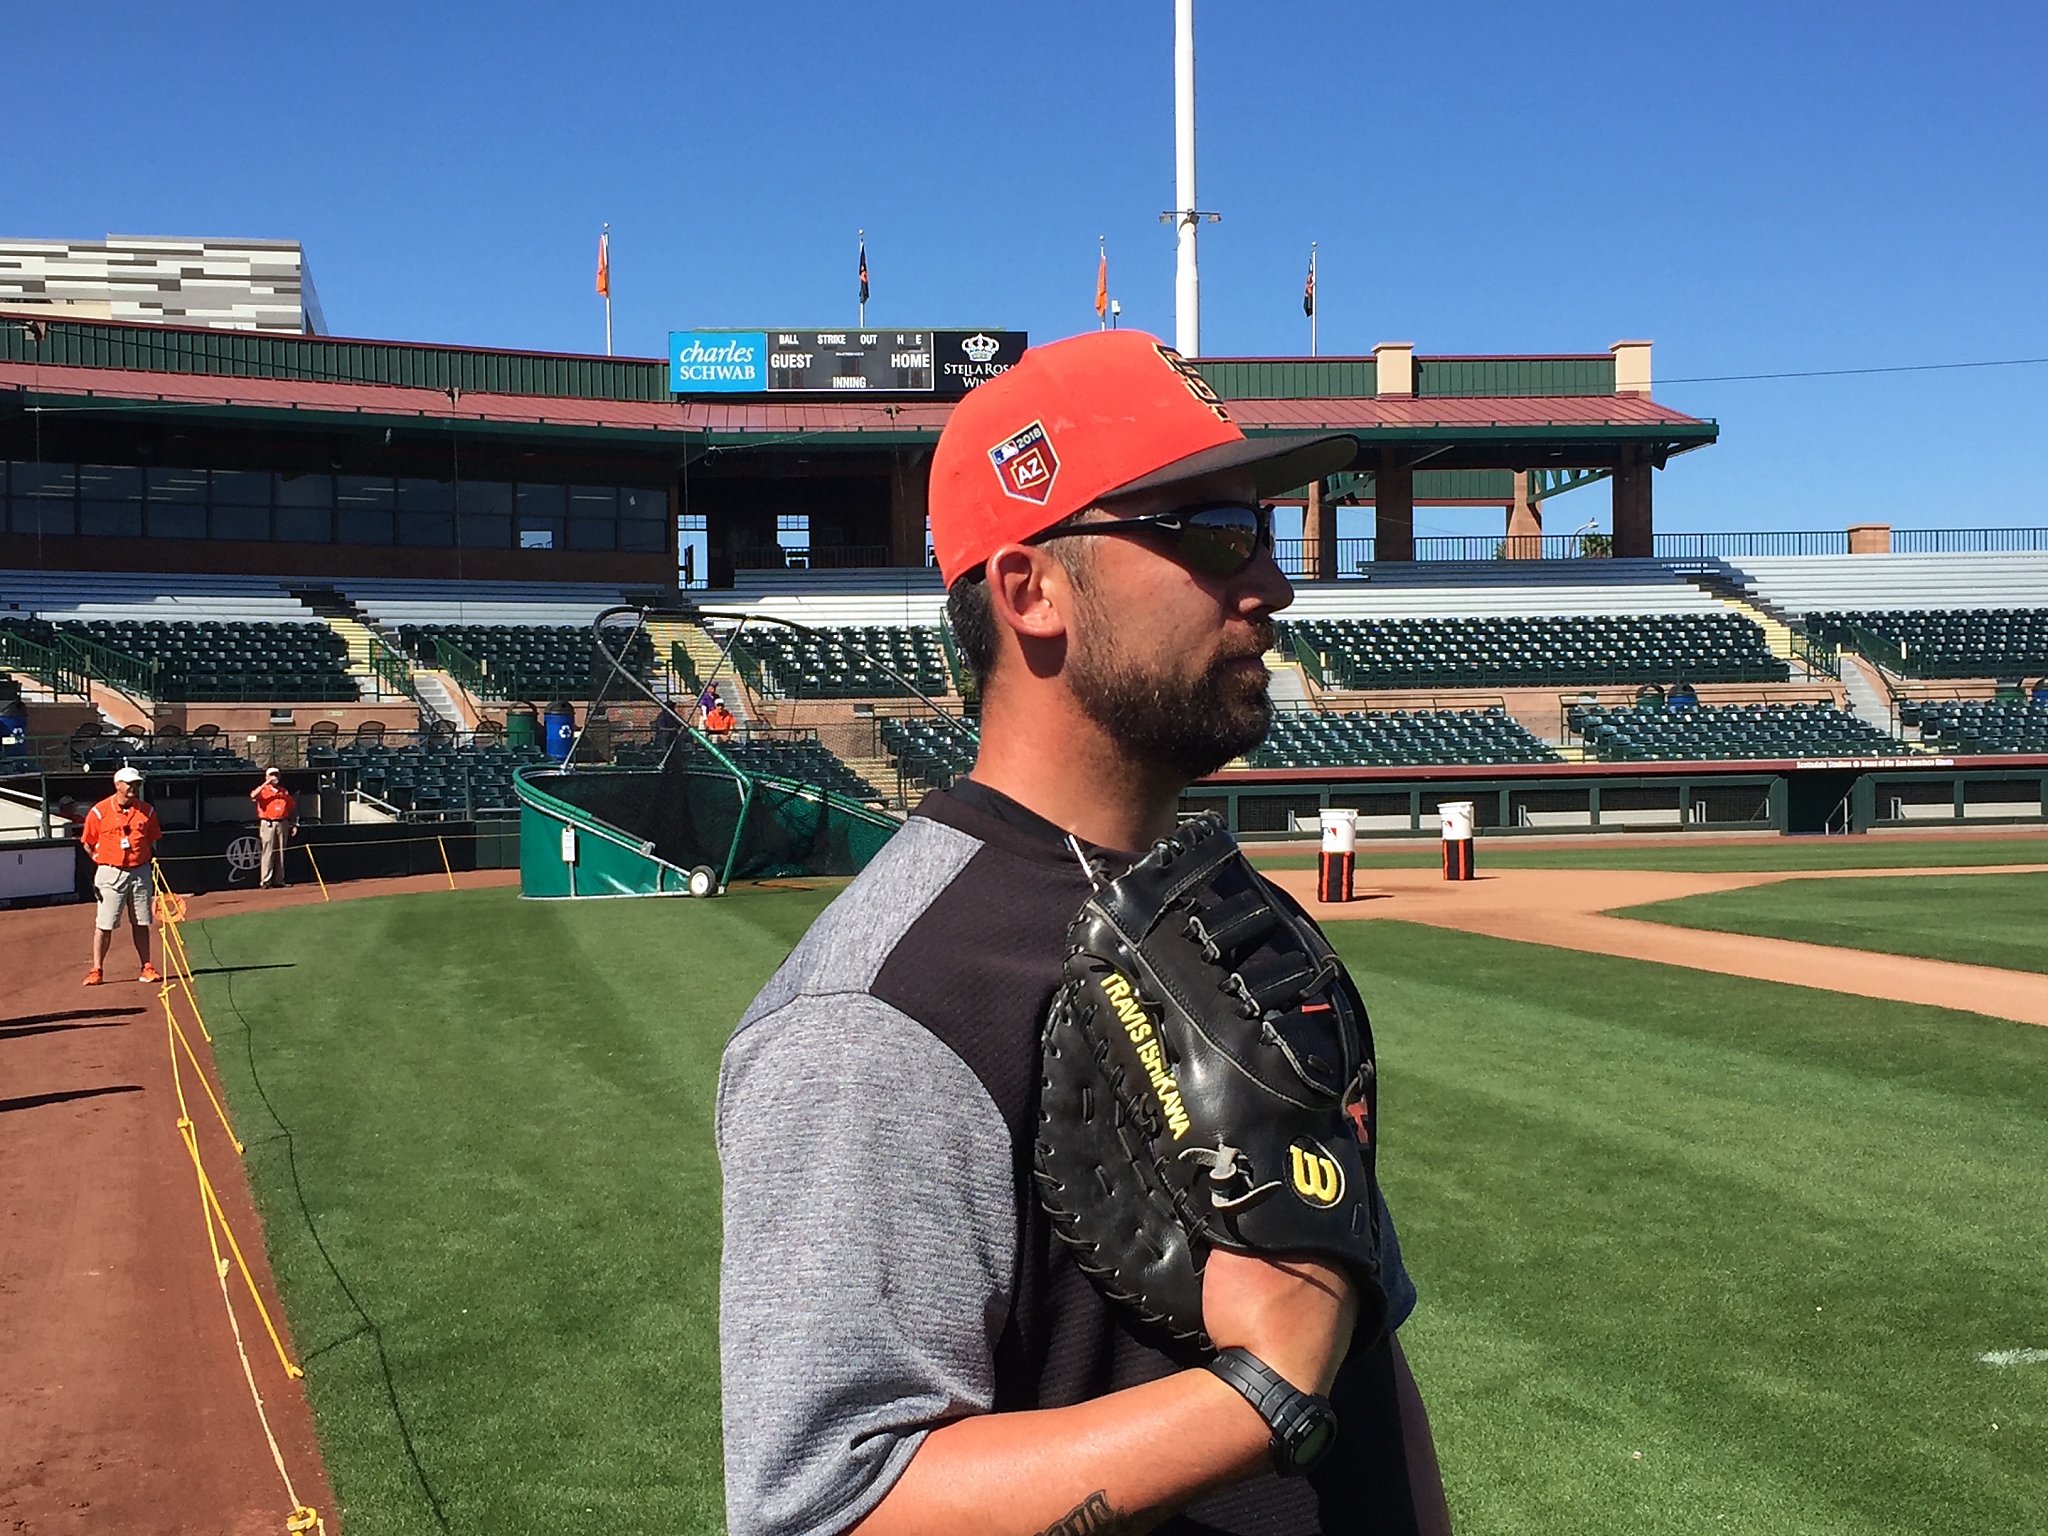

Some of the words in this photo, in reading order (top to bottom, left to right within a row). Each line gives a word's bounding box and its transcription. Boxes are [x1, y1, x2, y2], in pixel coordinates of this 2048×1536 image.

[779, 334, 799, 344] BALL
[817, 335, 846, 345] STRIKE
[860, 335, 877, 345] OUT
[897, 335, 904, 345] H
[915, 335, 922, 345] E
[680, 340, 754, 363] charles
[771, 353, 813, 368] GUEST
[891, 353, 930, 368] HOME
[680, 365, 755, 380] SCHWAB
[944, 363, 983, 376] STELLA
[833, 376, 867, 388] INNING
[1018, 457, 1043, 484] AZ
[1100, 973, 1152, 1043] TRAVIS
